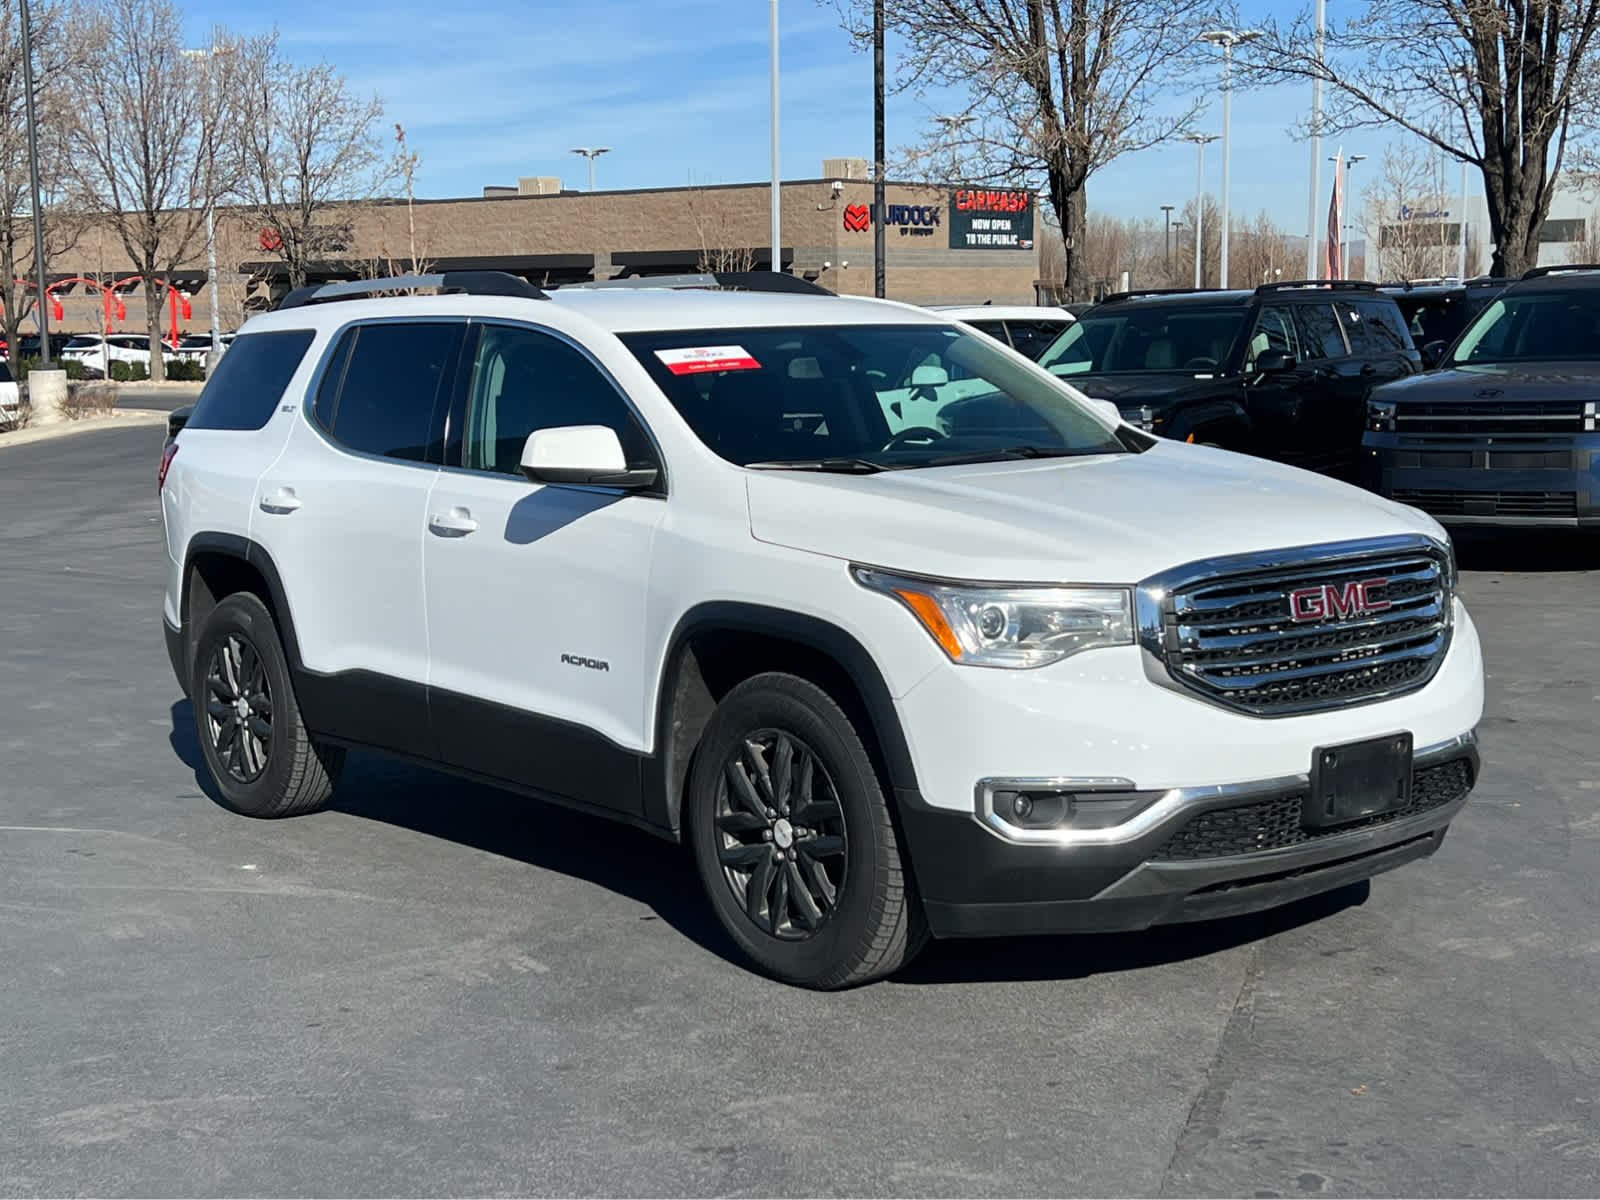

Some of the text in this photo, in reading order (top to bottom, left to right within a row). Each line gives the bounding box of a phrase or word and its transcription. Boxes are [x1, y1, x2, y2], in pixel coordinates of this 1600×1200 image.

[971, 219, 1011, 230] NOW OPEN
[966, 233, 976, 245] TO
[977, 233, 991, 245] THE
[992, 234, 1018, 245] PUBLIC
[1289, 577, 1392, 622] GMC
[561, 654, 609, 672] ACADIA
